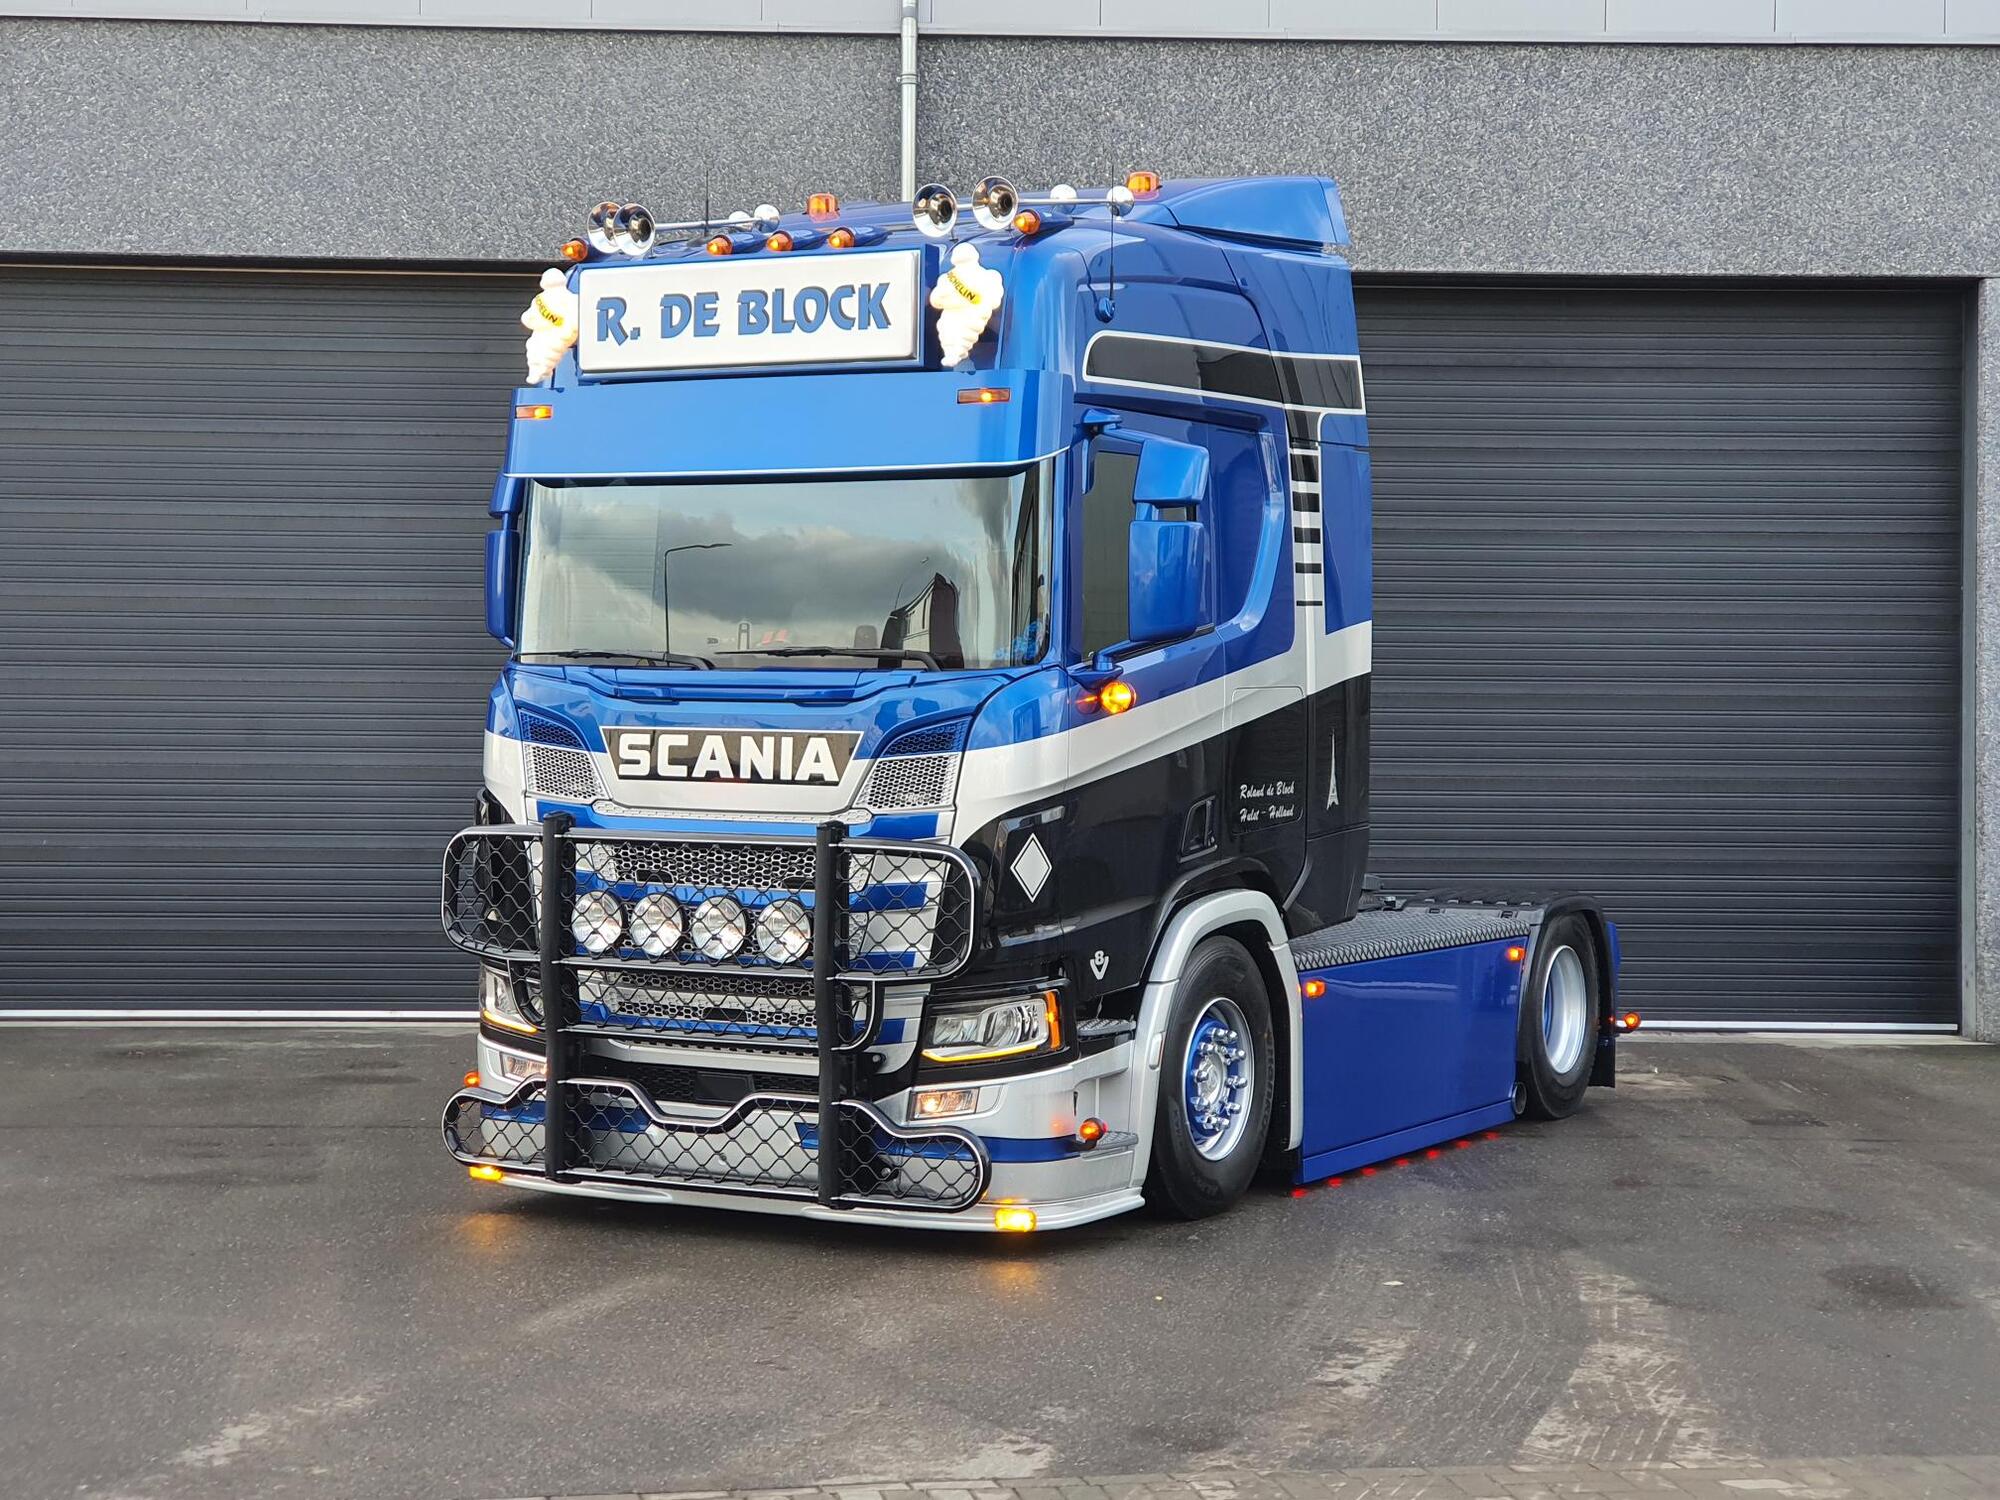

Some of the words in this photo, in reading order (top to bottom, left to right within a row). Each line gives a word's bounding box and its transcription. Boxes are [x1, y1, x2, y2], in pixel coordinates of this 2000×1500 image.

[596, 296, 641, 346] R.
[660, 291, 720, 339] DE
[737, 282, 892, 335] BLOCK
[618, 733, 839, 782] SCANIA
[1240, 783, 1265, 799] Roland
[1266, 783, 1275, 796] de
[1276, 780, 1295, 796] Block
[1268, 804, 1295, 820] Holland
